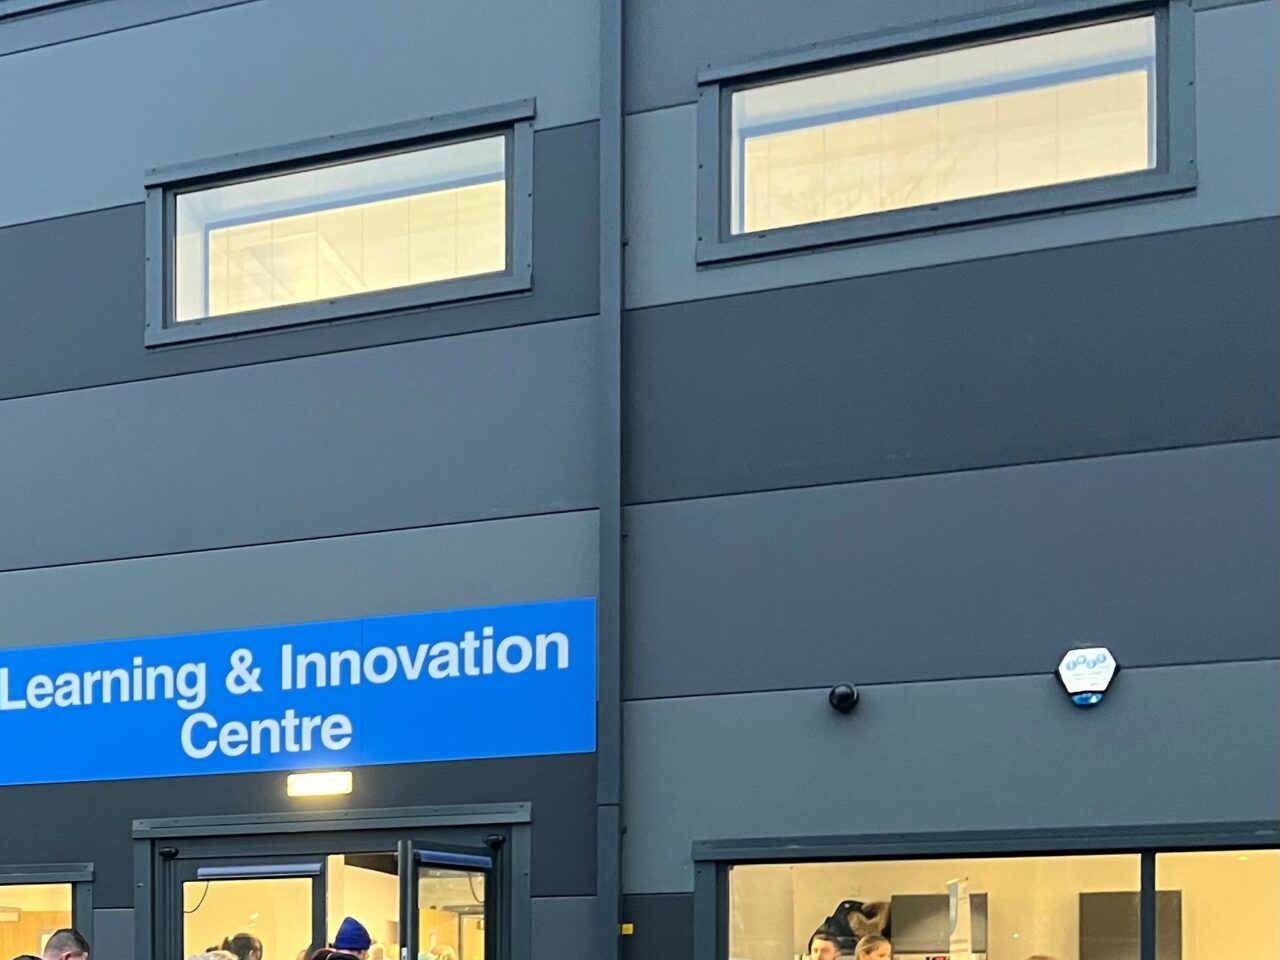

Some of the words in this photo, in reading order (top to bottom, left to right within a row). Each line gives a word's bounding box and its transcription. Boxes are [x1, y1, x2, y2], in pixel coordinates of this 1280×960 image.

[225, 647, 264, 696] &
[280, 626, 572, 691] Innovation
[180, 709, 355, 760] Centre
